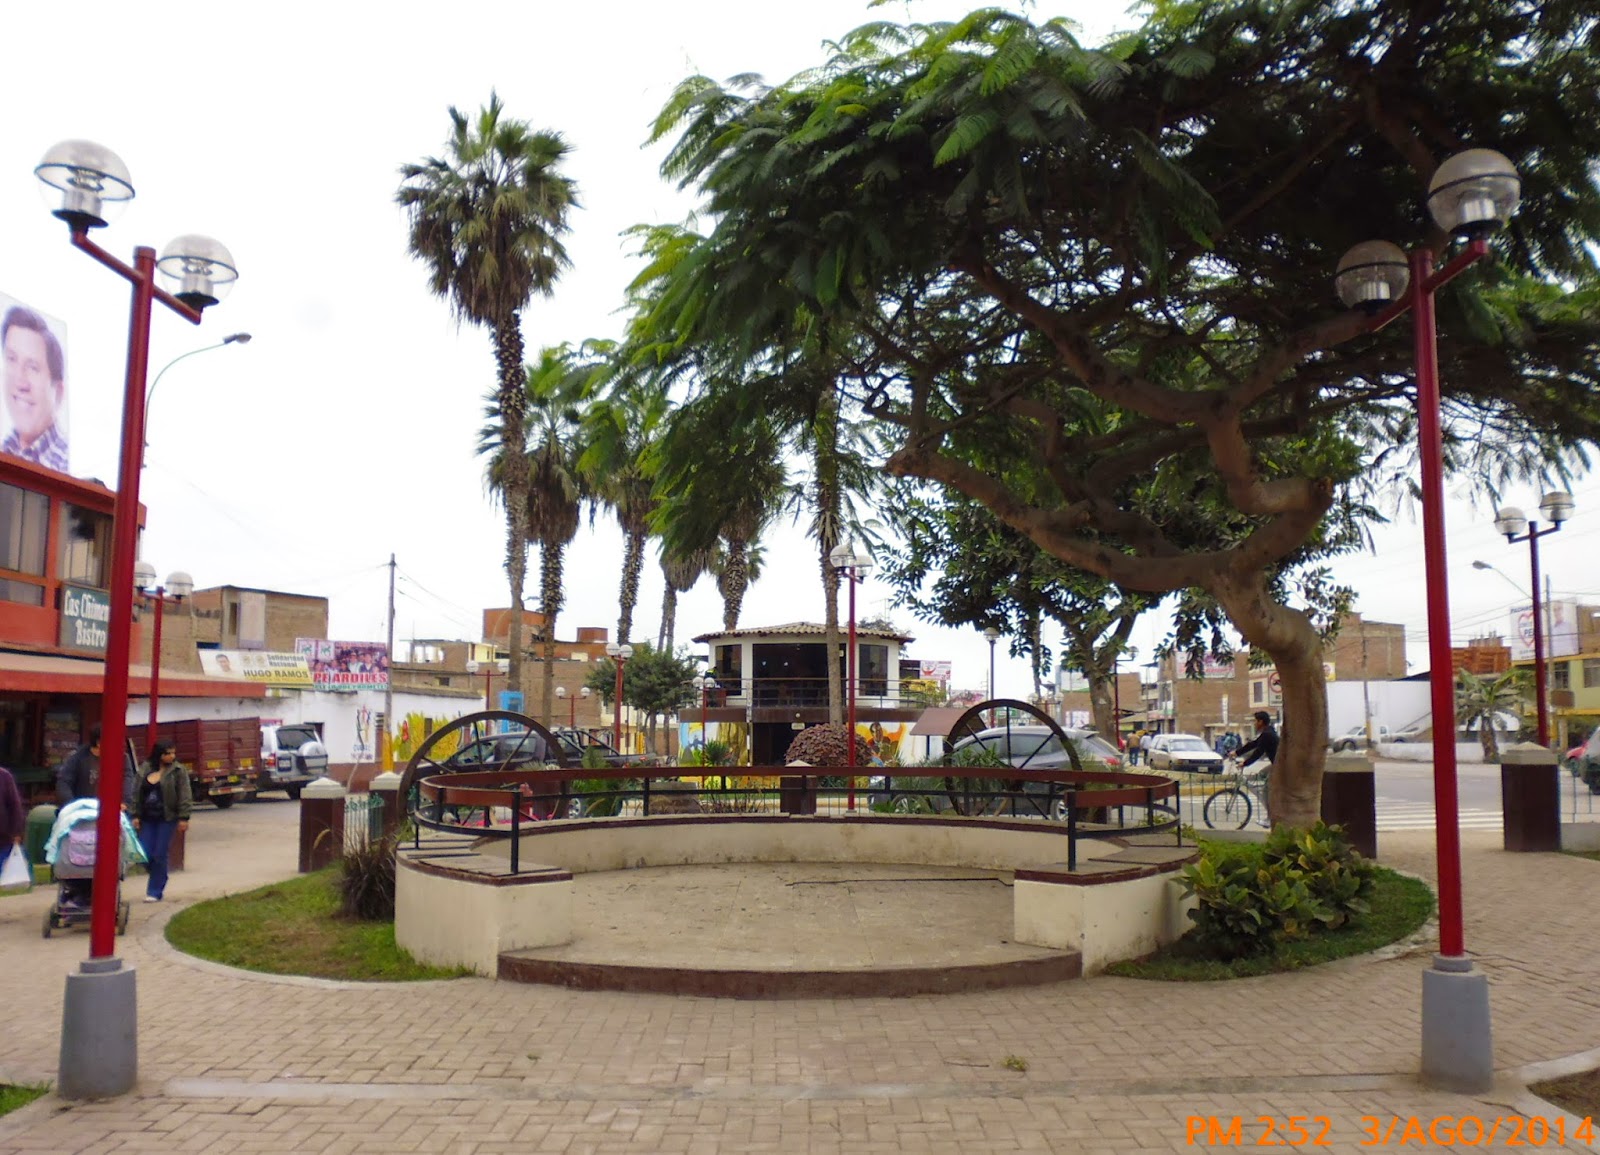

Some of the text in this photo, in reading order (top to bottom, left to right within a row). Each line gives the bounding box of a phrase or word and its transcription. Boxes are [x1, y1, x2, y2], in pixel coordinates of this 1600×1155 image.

[75, 619, 106, 648] Bistro
[243, 669, 309, 679] HUGO RAMOS
[313, 673, 388, 684] PE ARDILES
